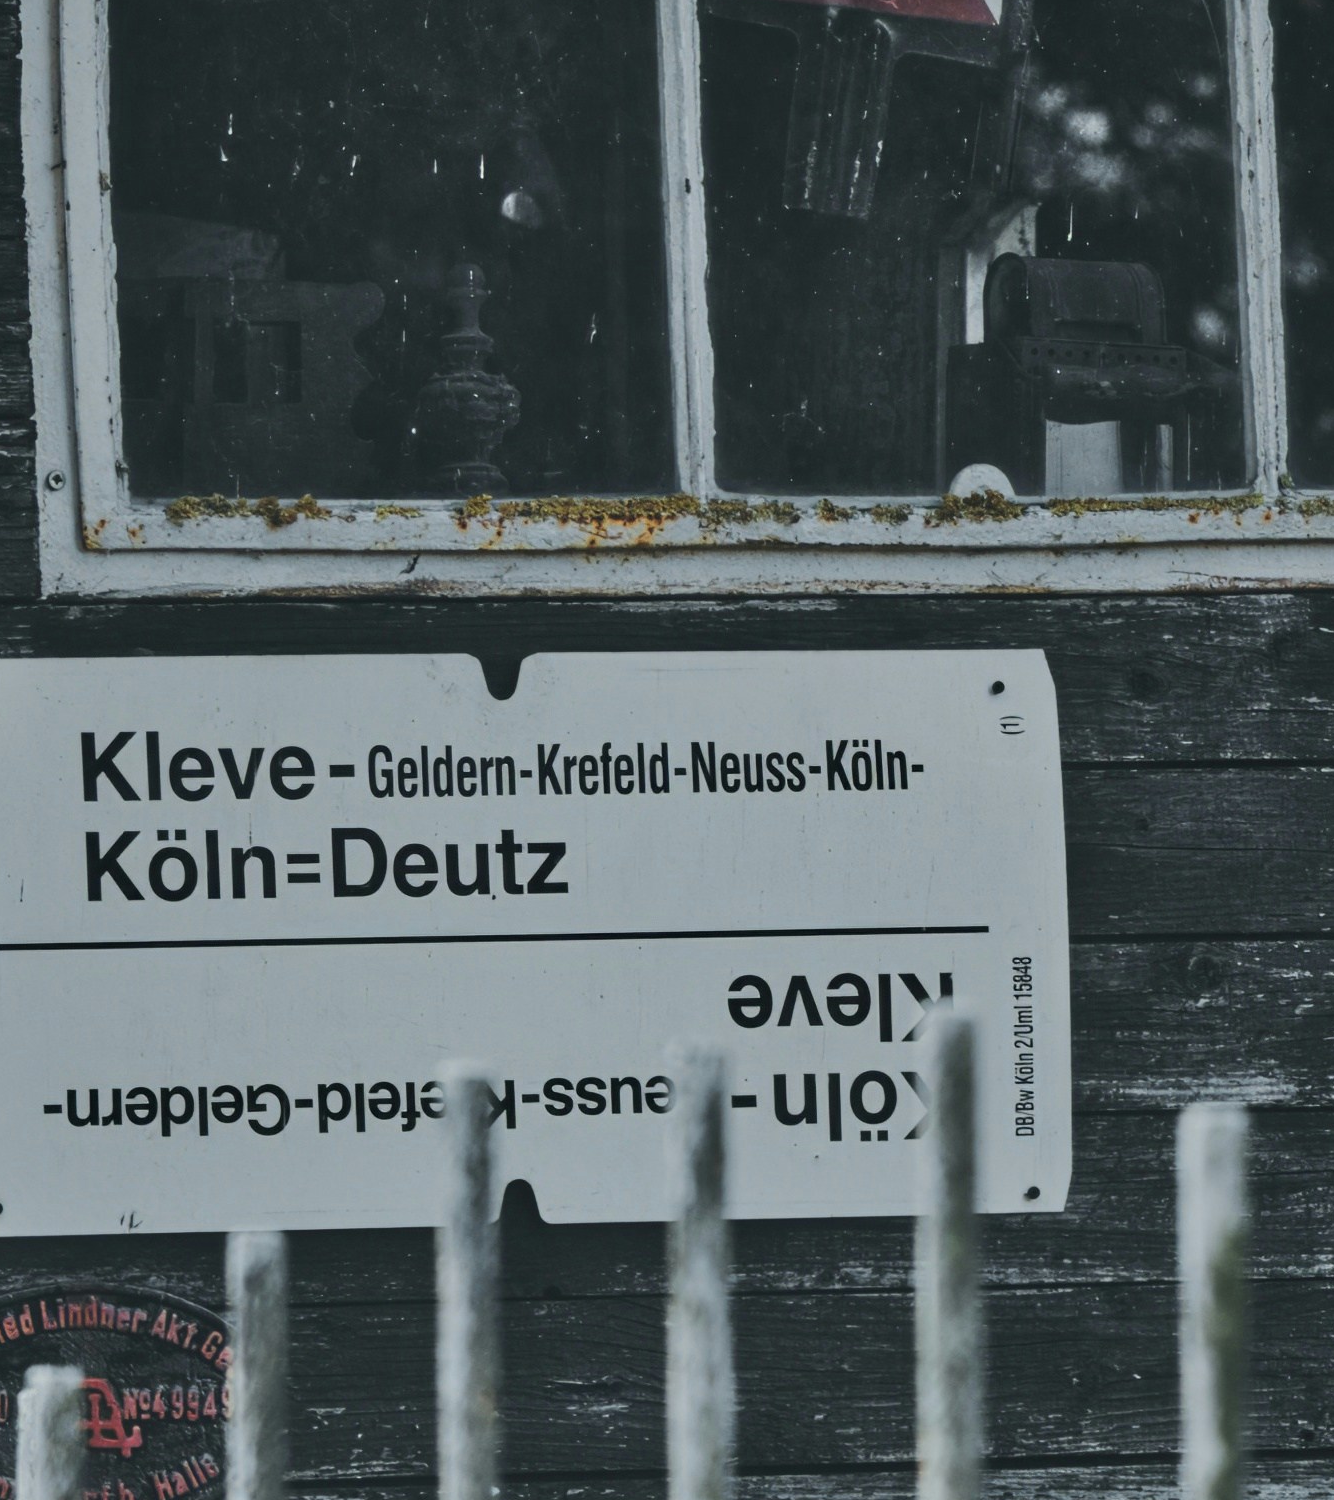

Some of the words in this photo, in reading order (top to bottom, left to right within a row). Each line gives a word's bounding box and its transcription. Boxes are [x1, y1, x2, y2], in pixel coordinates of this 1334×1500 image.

[85, 827, 570, 902] Köln=Deutz
[1012, 956, 1033, 1001] 15848
[727, 972, 954, 1042] Kleve
[1014, 1053, 1034, 1085] Köln
[1014, 1089, 1035, 1138] DB/Bw
